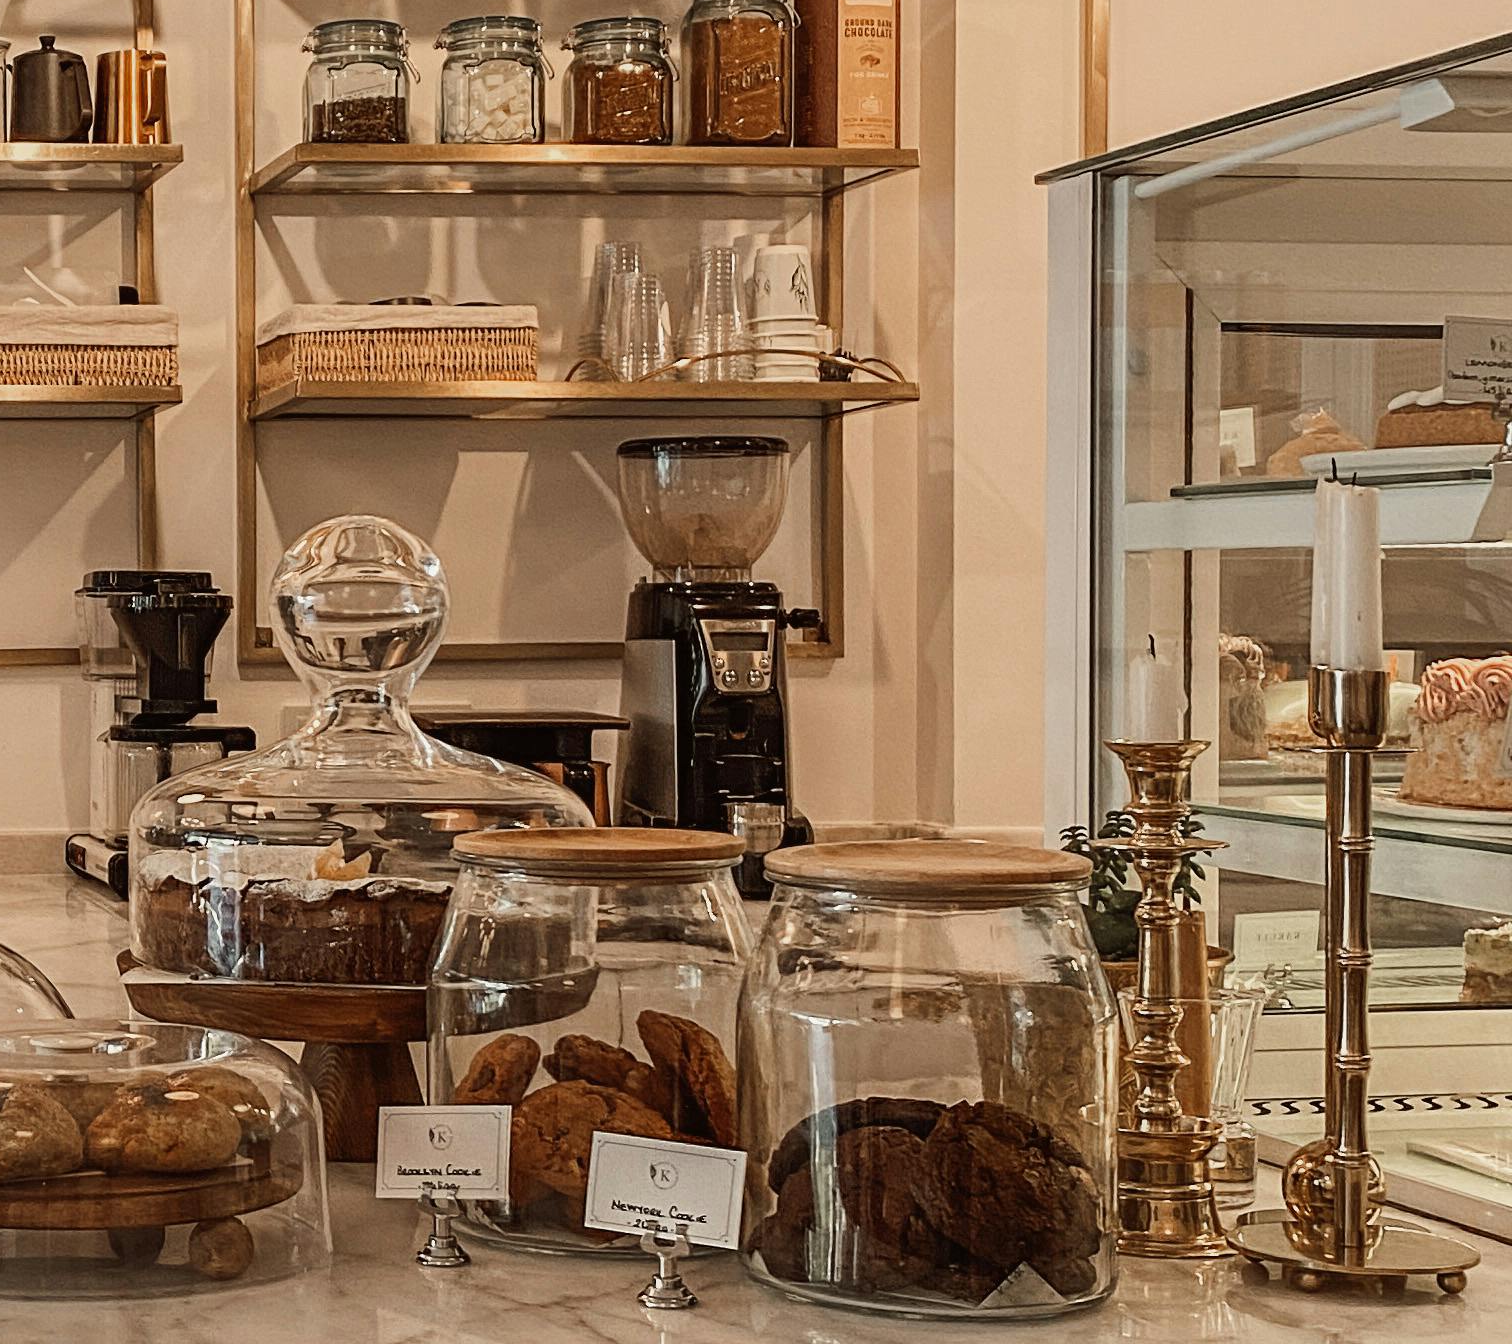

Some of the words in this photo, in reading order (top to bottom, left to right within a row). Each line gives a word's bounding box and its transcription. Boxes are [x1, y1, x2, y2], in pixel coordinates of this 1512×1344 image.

[845, 18, 874, 27] GROUND
[844, 27, 893, 39] CHOCOLATE
[660, 1168, 671, 1183] K
